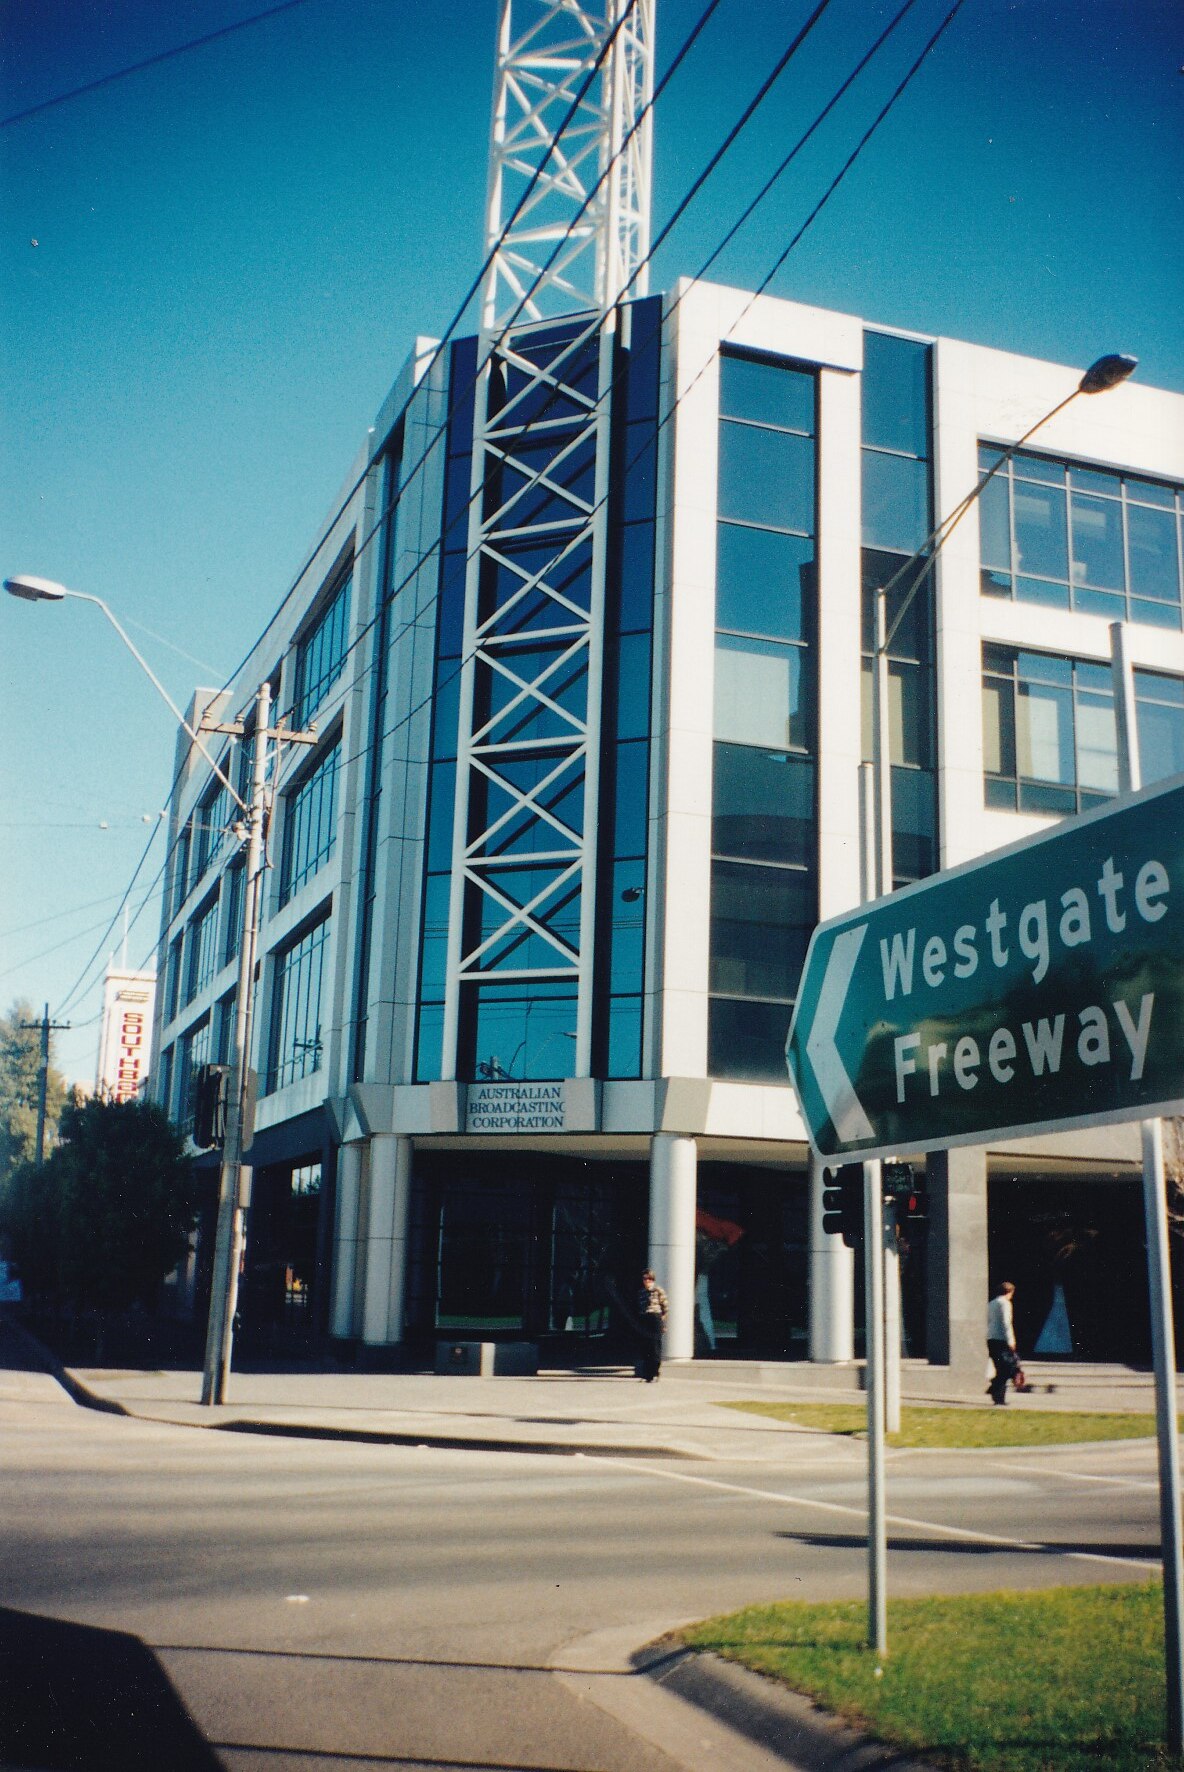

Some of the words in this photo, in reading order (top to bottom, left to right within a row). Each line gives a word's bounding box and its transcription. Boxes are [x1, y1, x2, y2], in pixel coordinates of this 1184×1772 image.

[879, 856, 1170, 1001] Westgate
[893, 992, 1155, 1103] Freeway
[472, 1116, 564, 1129] CORPORATION
[478, 1087, 561, 1100] AUSTRALIAN
